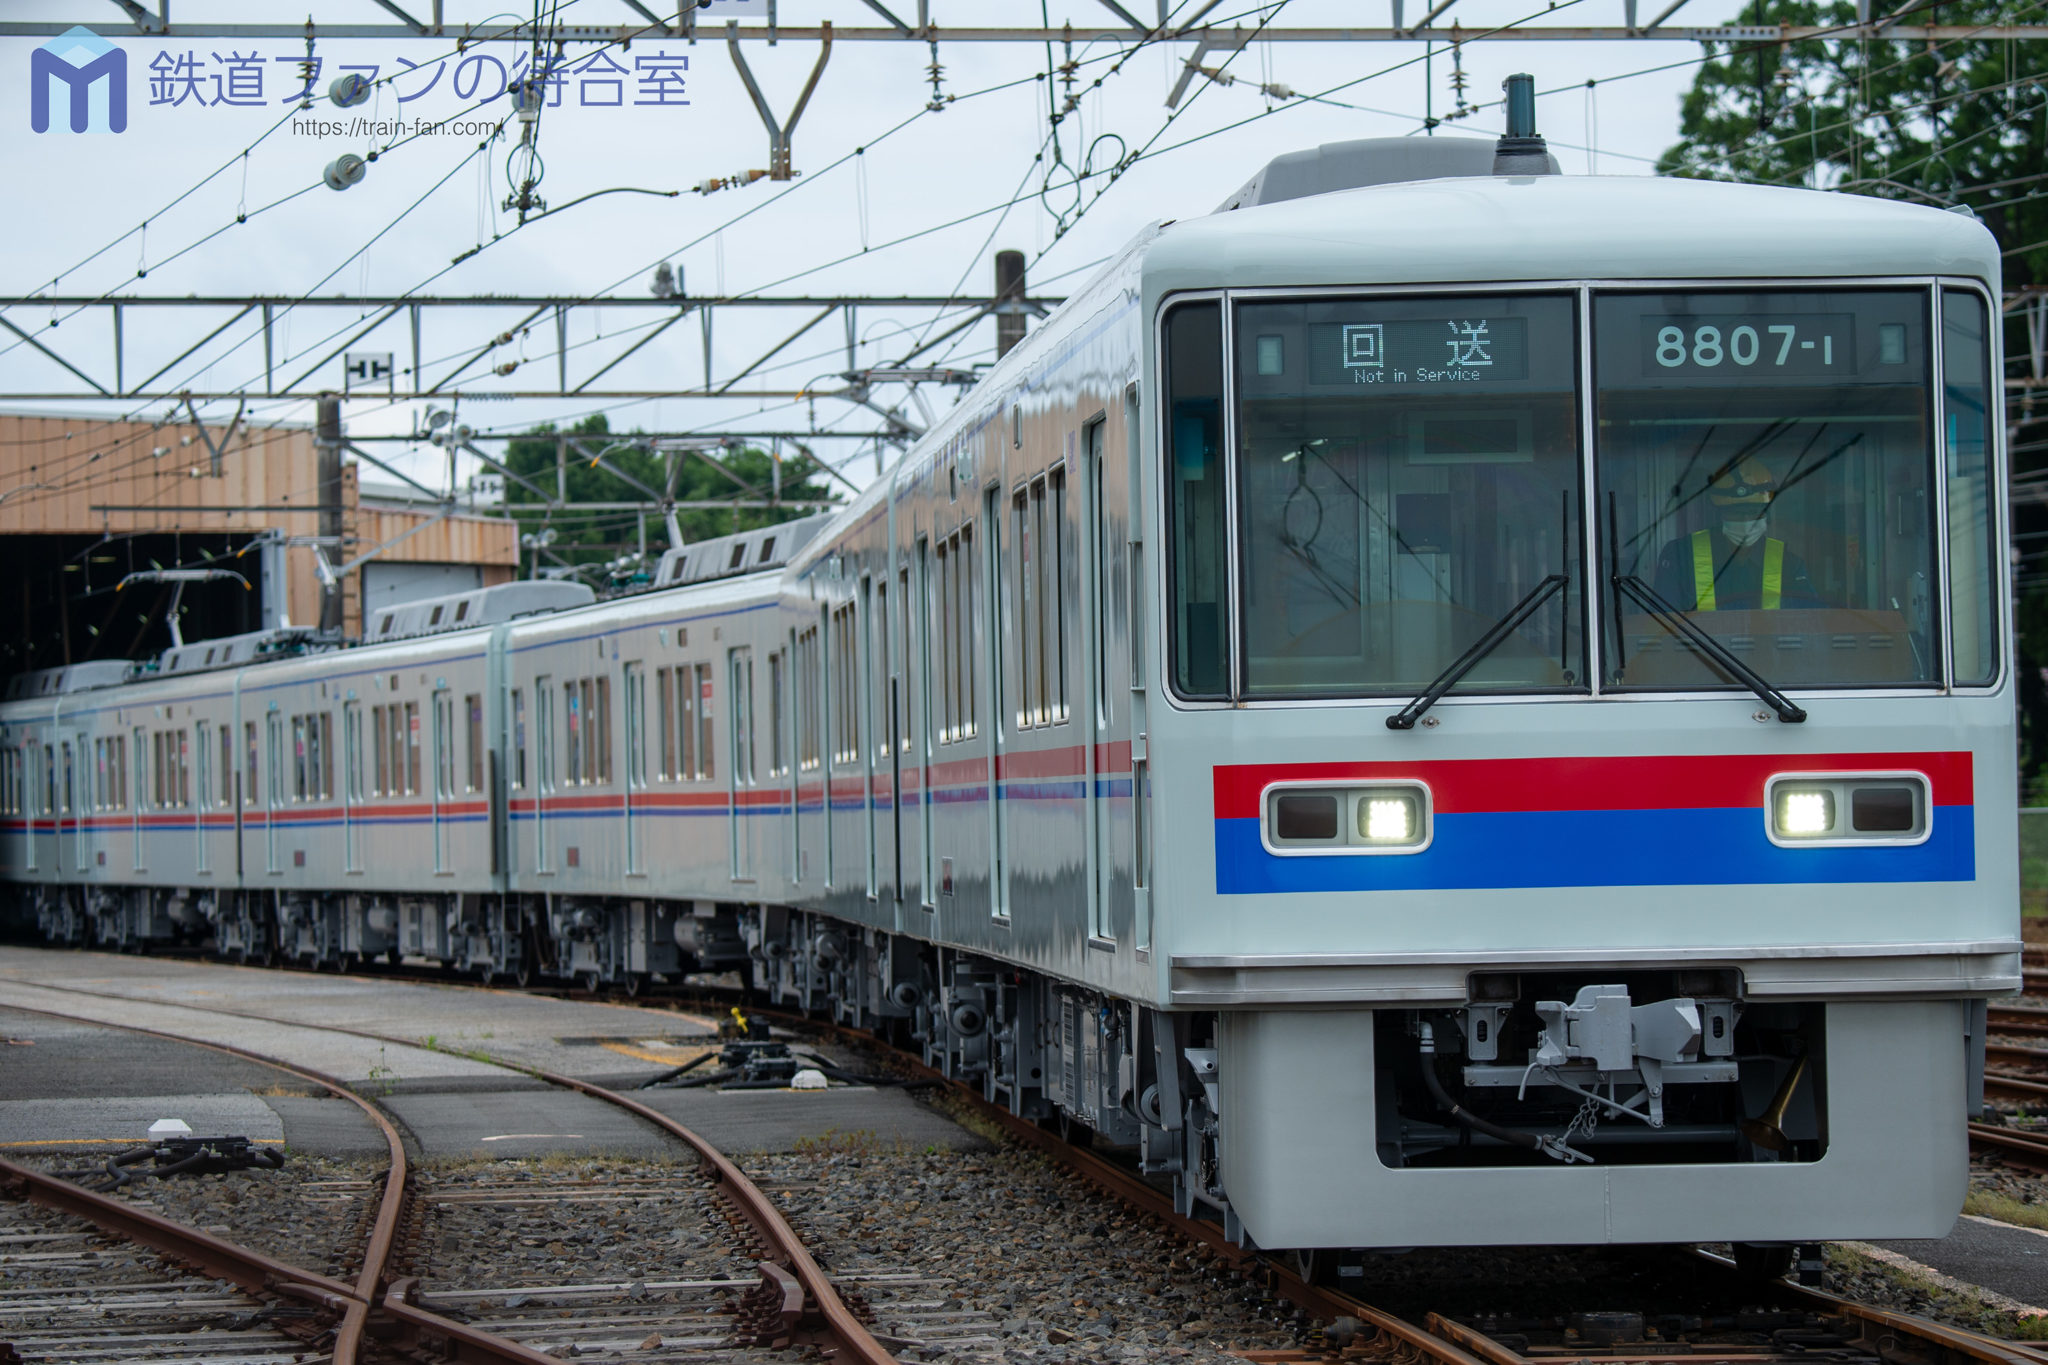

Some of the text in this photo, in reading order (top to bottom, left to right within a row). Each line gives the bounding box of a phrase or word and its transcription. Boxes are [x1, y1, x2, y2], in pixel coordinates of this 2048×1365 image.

[1354, 367, 1480, 384] Not in Service
